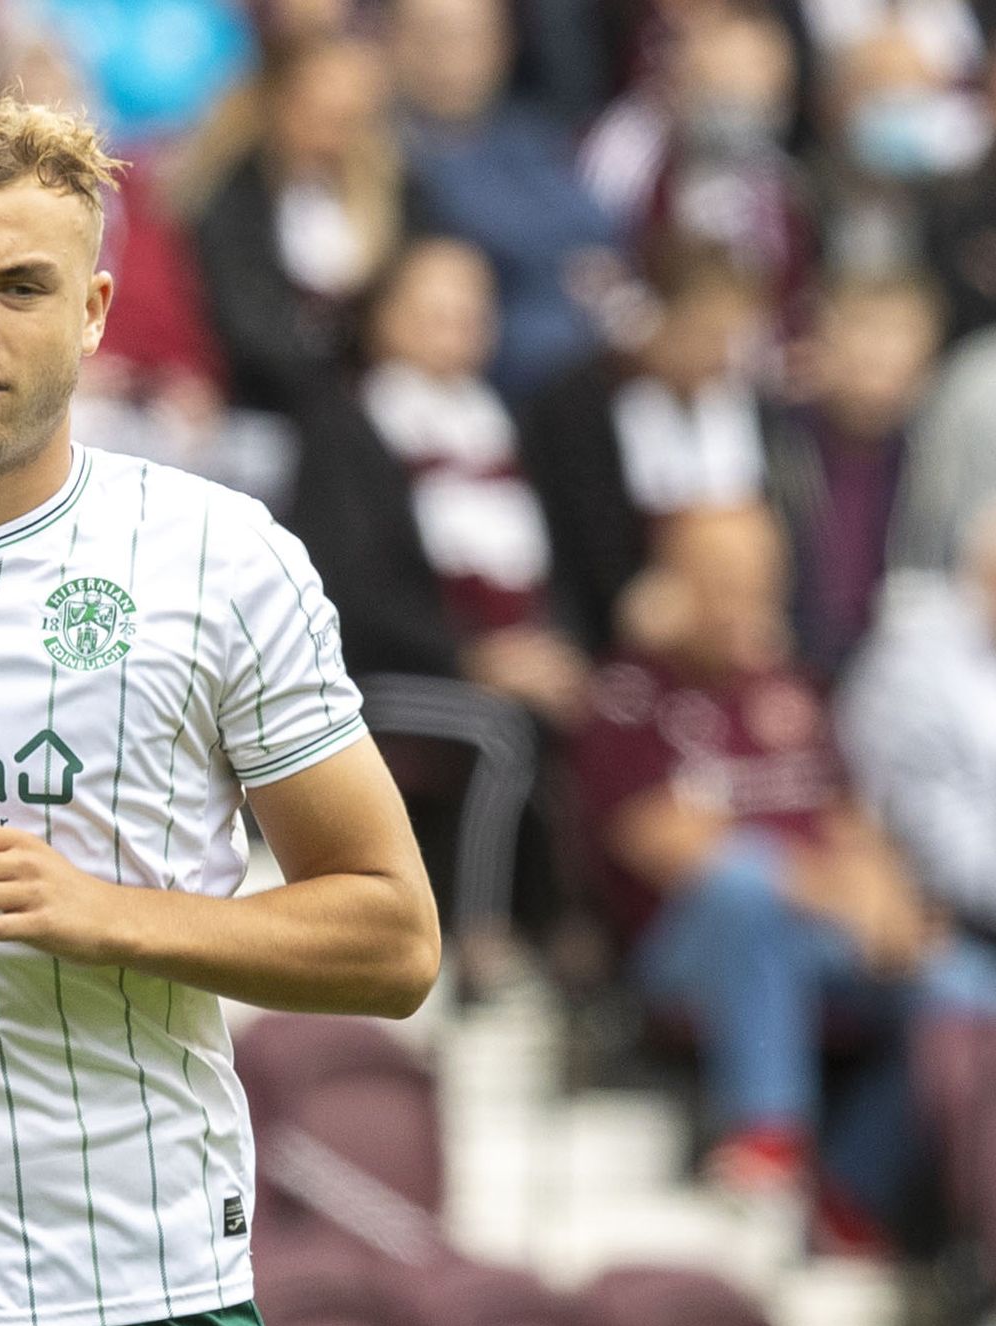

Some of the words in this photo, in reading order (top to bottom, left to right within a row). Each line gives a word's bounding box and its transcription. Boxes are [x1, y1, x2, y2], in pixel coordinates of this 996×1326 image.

[49, 578, 133, 612] HIBERNIAN
[41, 617, 60, 632] 18
[119, 621, 137, 636] 75
[47, 643, 125, 671] EDINBURGH
